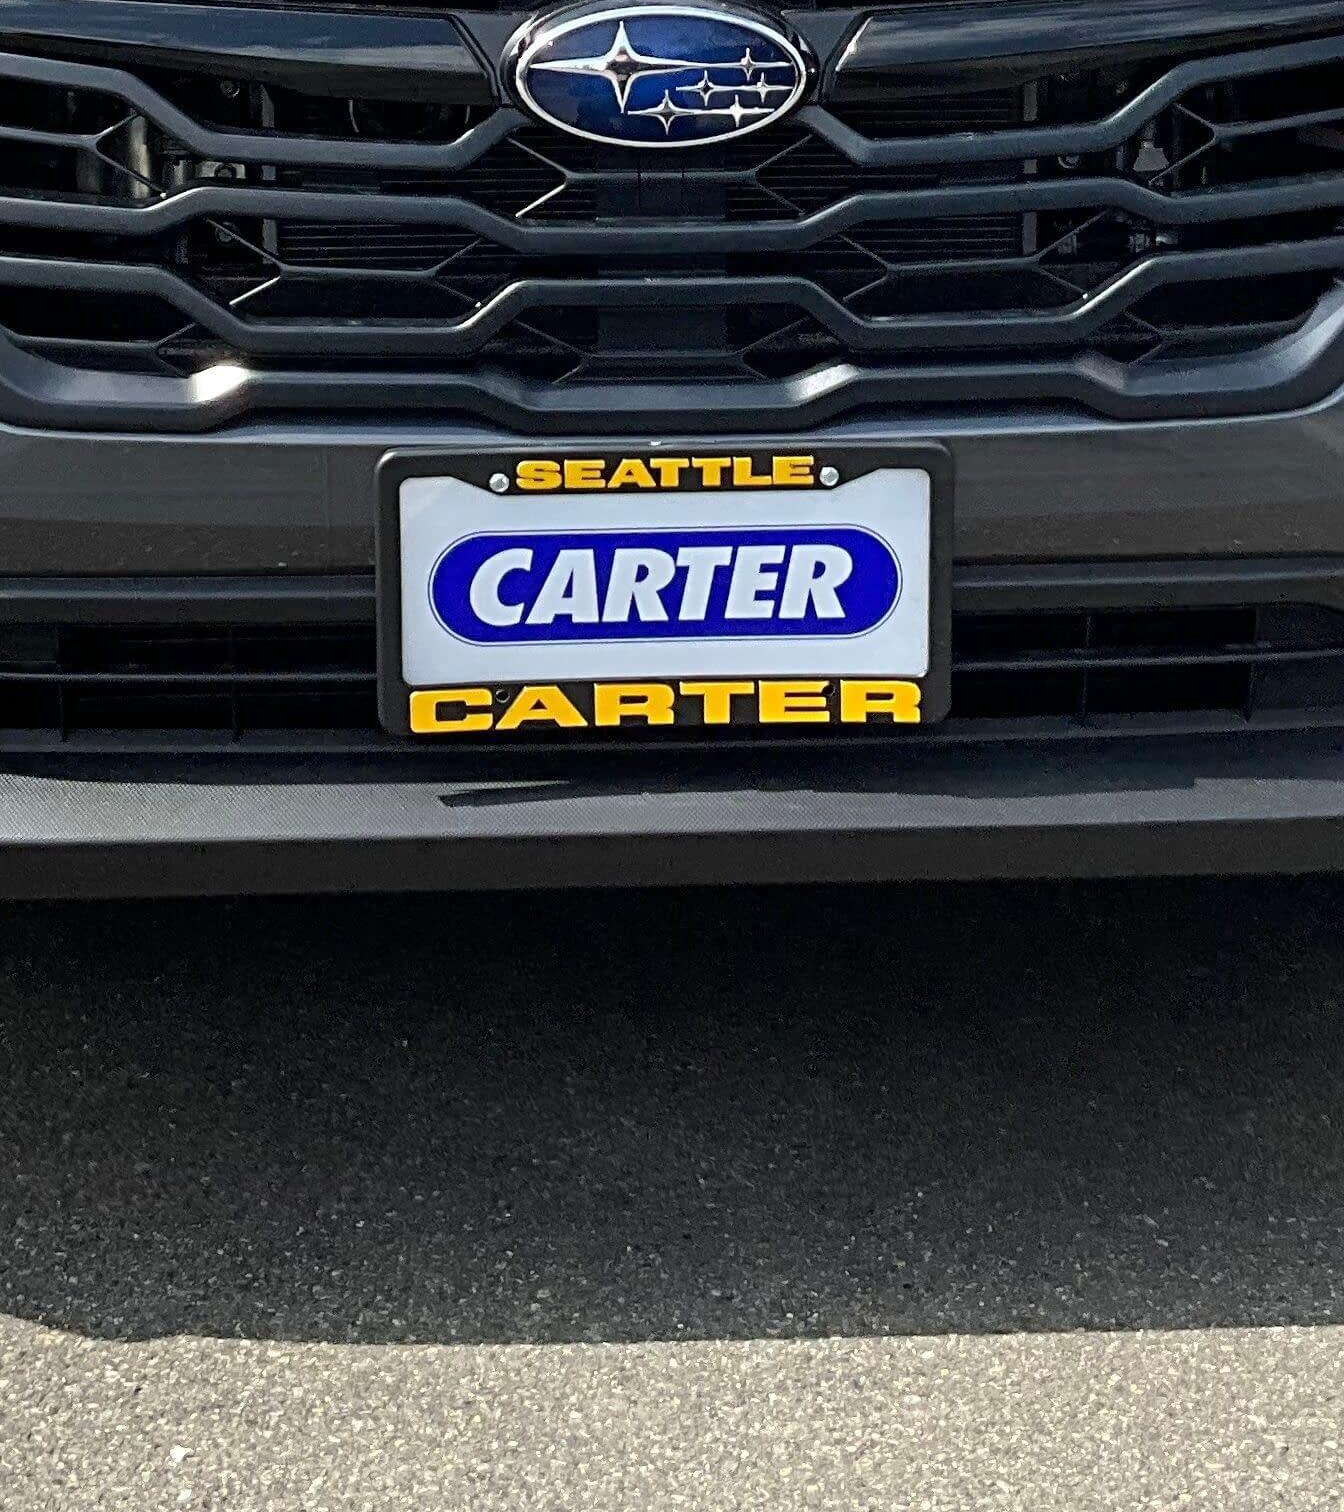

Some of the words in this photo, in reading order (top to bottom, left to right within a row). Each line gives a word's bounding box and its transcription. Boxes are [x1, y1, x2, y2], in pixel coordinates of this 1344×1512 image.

[515, 455, 815, 491] SEATTLE
[469, 544, 854, 627] CARTER
[408, 680, 923, 734] CARTER
